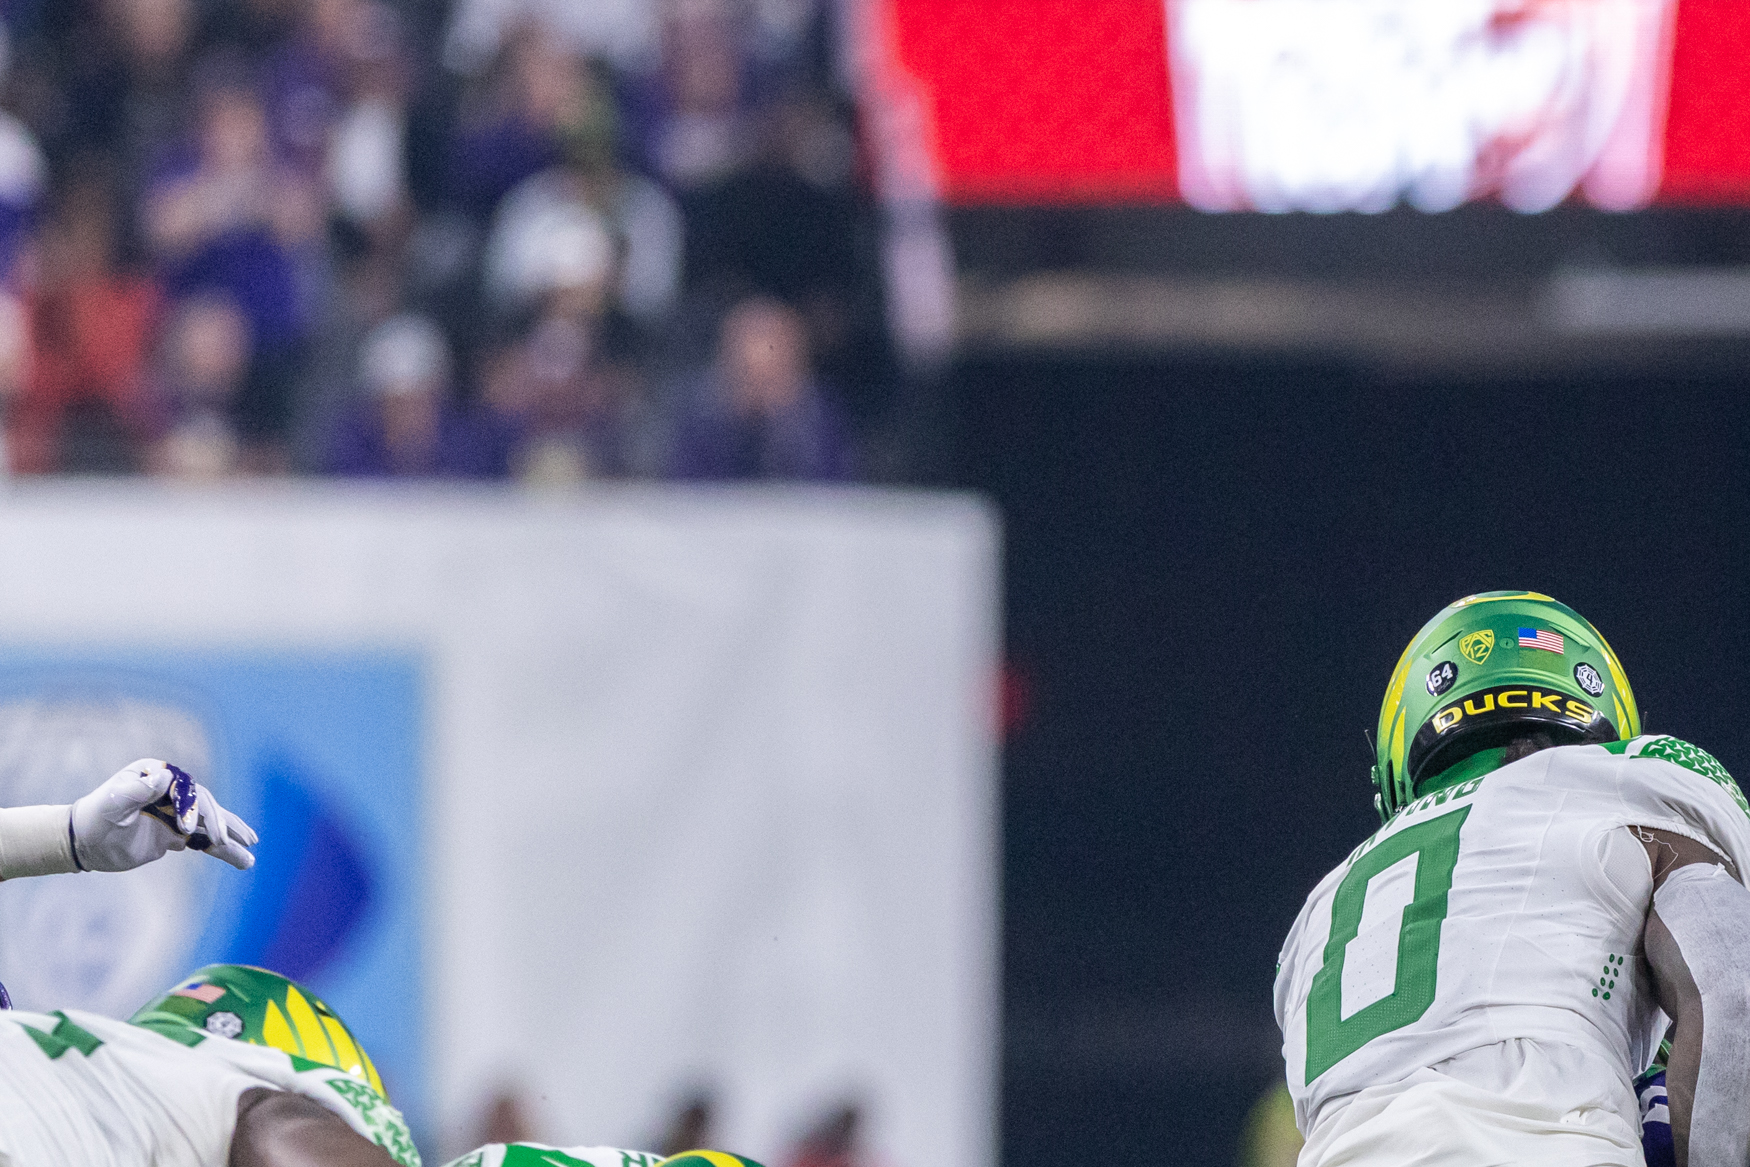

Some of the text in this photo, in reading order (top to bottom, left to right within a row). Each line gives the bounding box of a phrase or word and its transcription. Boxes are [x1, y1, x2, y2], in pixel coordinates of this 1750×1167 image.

[1461, 632, 1492, 655] PAC
[1470, 644, 1488, 659] 12
[1431, 663, 1453, 688] 64
[1432, 690, 1595, 734] DUCKS
[1304, 803, 1473, 1087] 0
